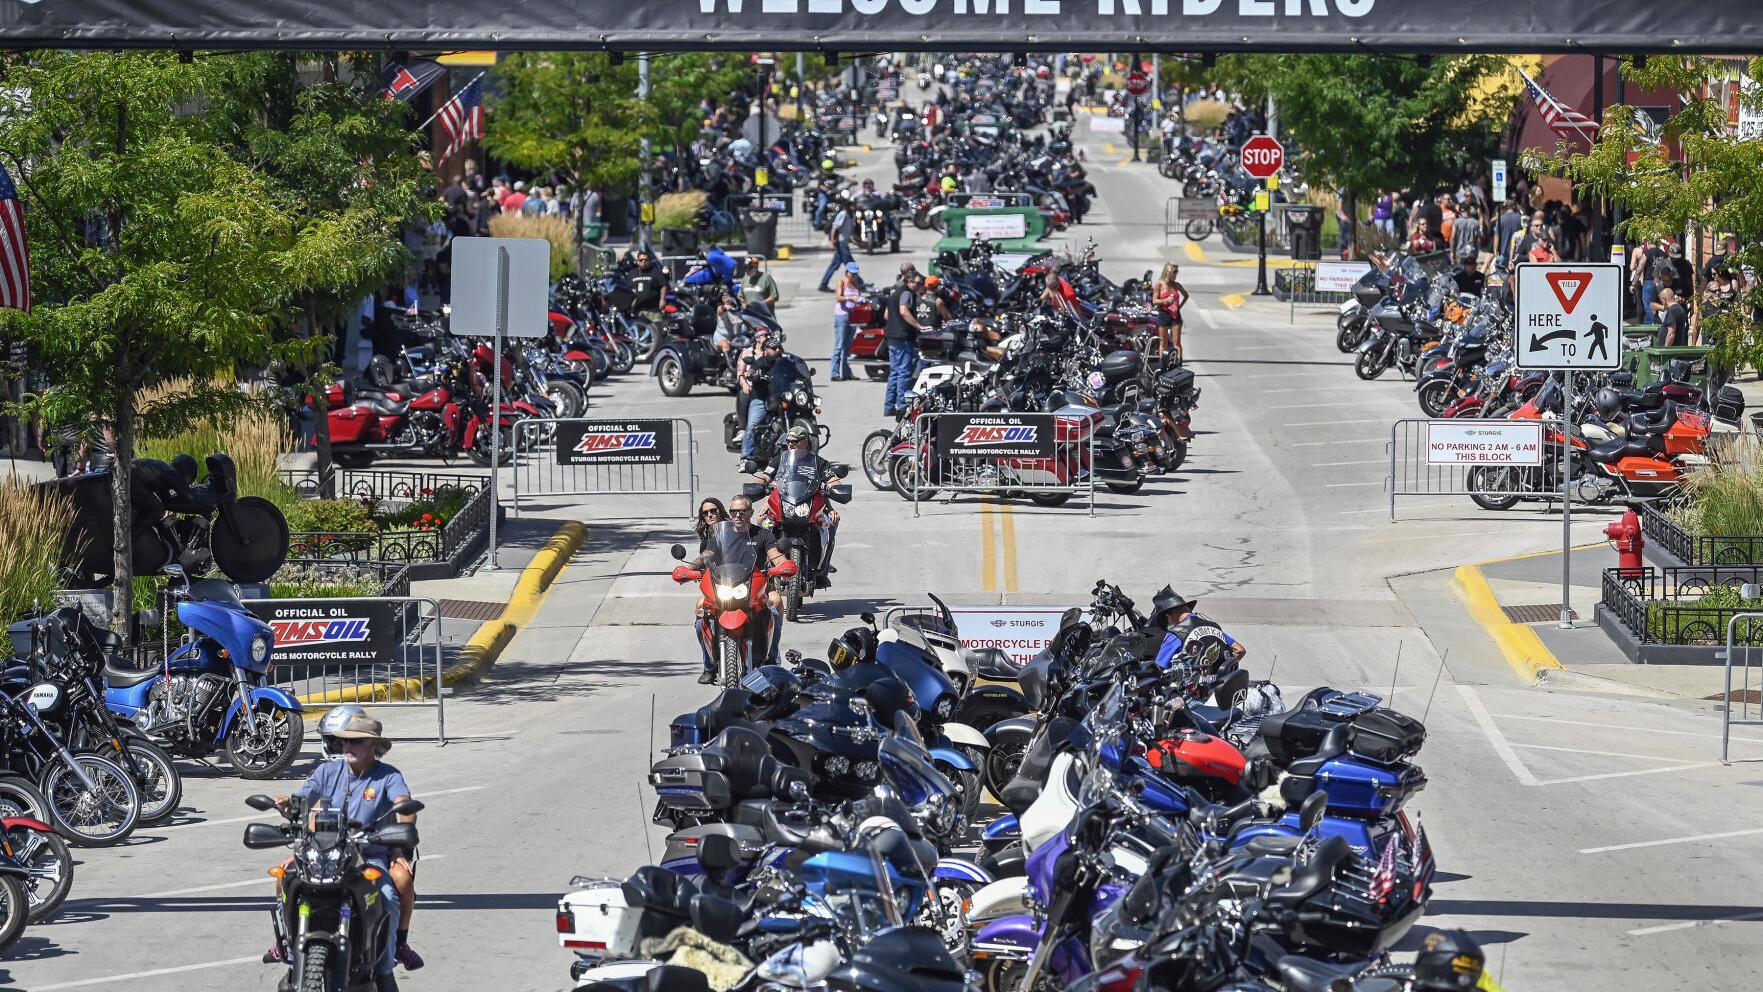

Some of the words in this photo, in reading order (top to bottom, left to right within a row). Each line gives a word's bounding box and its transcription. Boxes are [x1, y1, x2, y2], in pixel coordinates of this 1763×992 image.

[1244, 148, 1280, 165] STOP
[1528, 313, 1562, 327] HERE
[1560, 343, 1576, 357] TO
[955, 426, 1037, 445] AMSOIL
[574, 433, 655, 453] AMSOIL
[1431, 443, 1444, 451] NO
[1446, 443, 1486, 451] PARKING
[1488, 443, 1493, 451] 2
[1494, 443, 1509, 451] AM
[1515, 443, 1521, 451] 6
[1522, 443, 1537, 451] AM
[1455, 452, 1476, 461] THIS
[1479, 453, 1512, 461] BLOCK
[275, 608, 326, 618] OFFICIAL
[329, 608, 349, 617] OIL
[268, 619, 370, 647] AMSOIL
[961, 639, 1041, 649] MOTORCYCLE
[289, 652, 348, 660] MOTORCYCLE
[349, 651, 377, 659] RALLY
